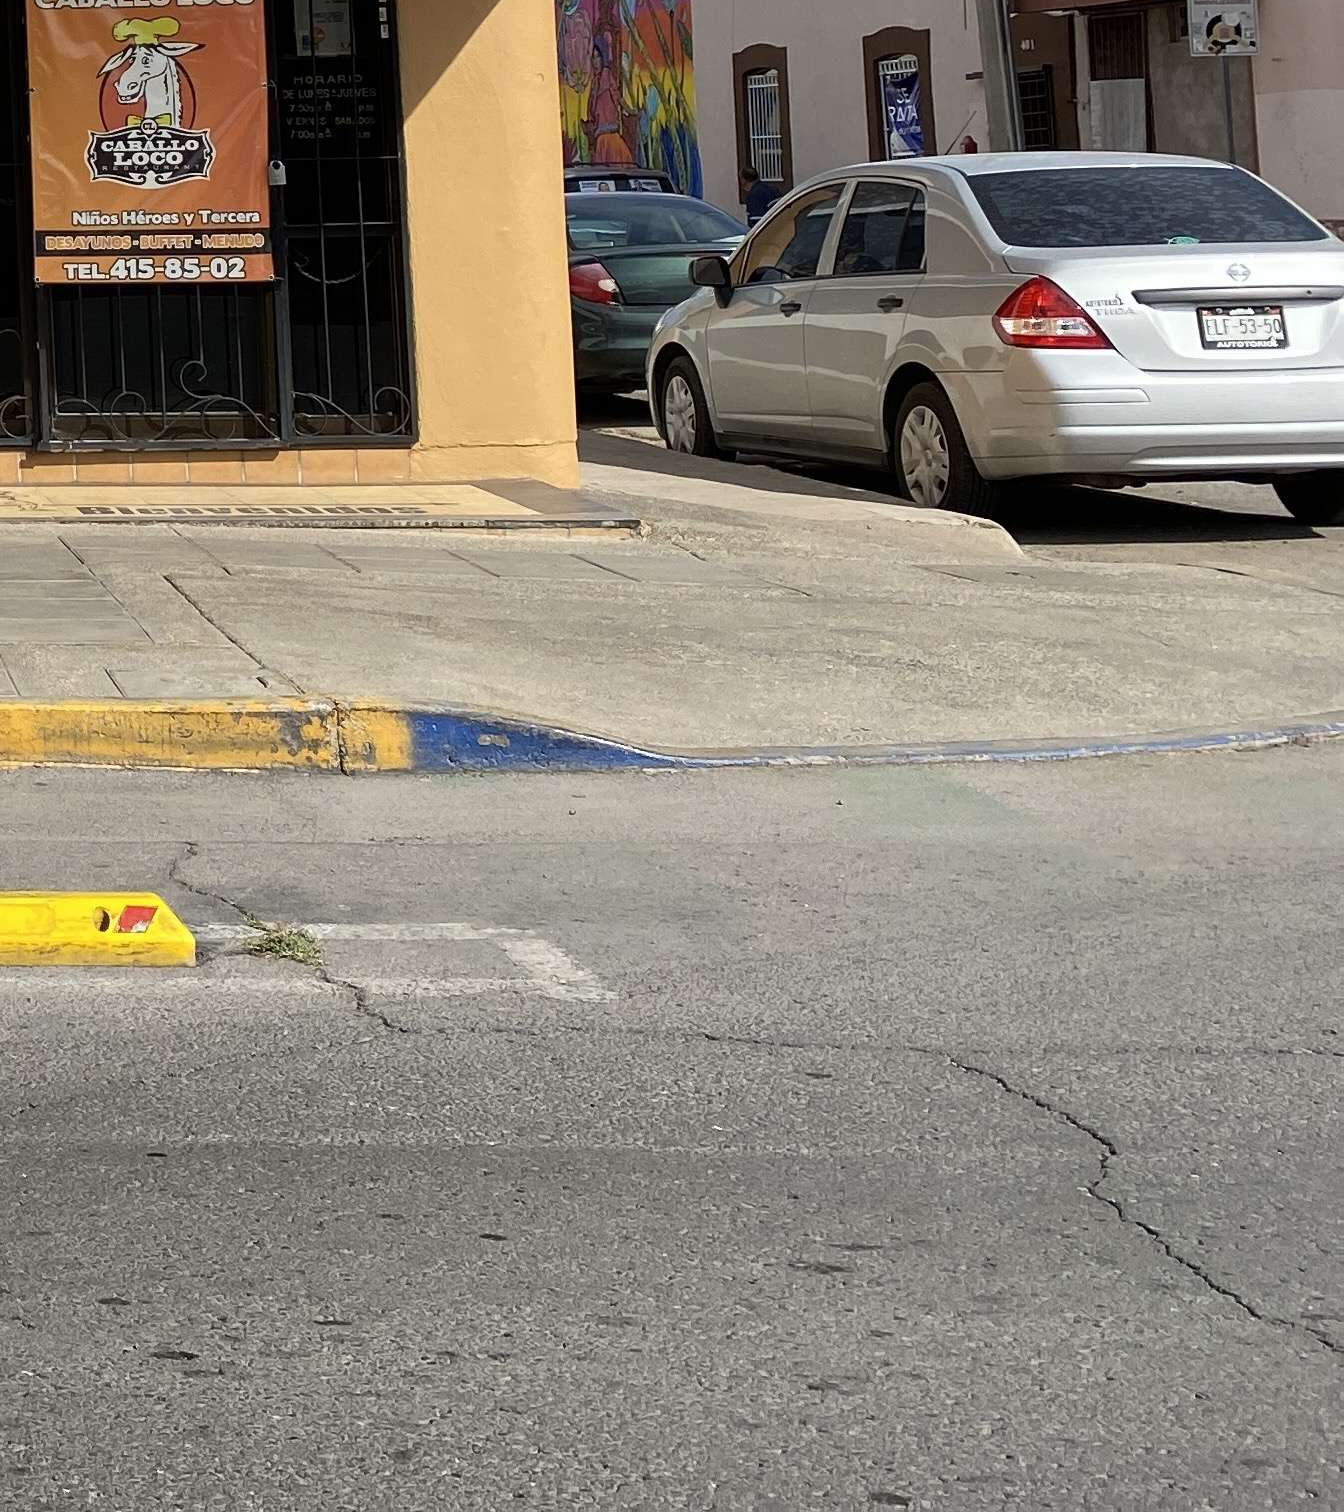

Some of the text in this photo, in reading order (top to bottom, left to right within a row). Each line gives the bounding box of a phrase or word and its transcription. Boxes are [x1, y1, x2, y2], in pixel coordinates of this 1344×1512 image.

[294, 74, 363, 85] HORARIO
[896, 88, 911, 104] SE
[100, 139, 200, 152] CABALLO
[113, 151, 184, 166] LOCO
[72, 209, 260, 226] Niños Héroes y Tercera
[45, 235, 132, 250] DESAYUNOS
[139, 234, 193, 250] BUFFET
[202, 233, 265, 249] MENUDO
[1205, 318, 1282, 336] ELF-53-50
